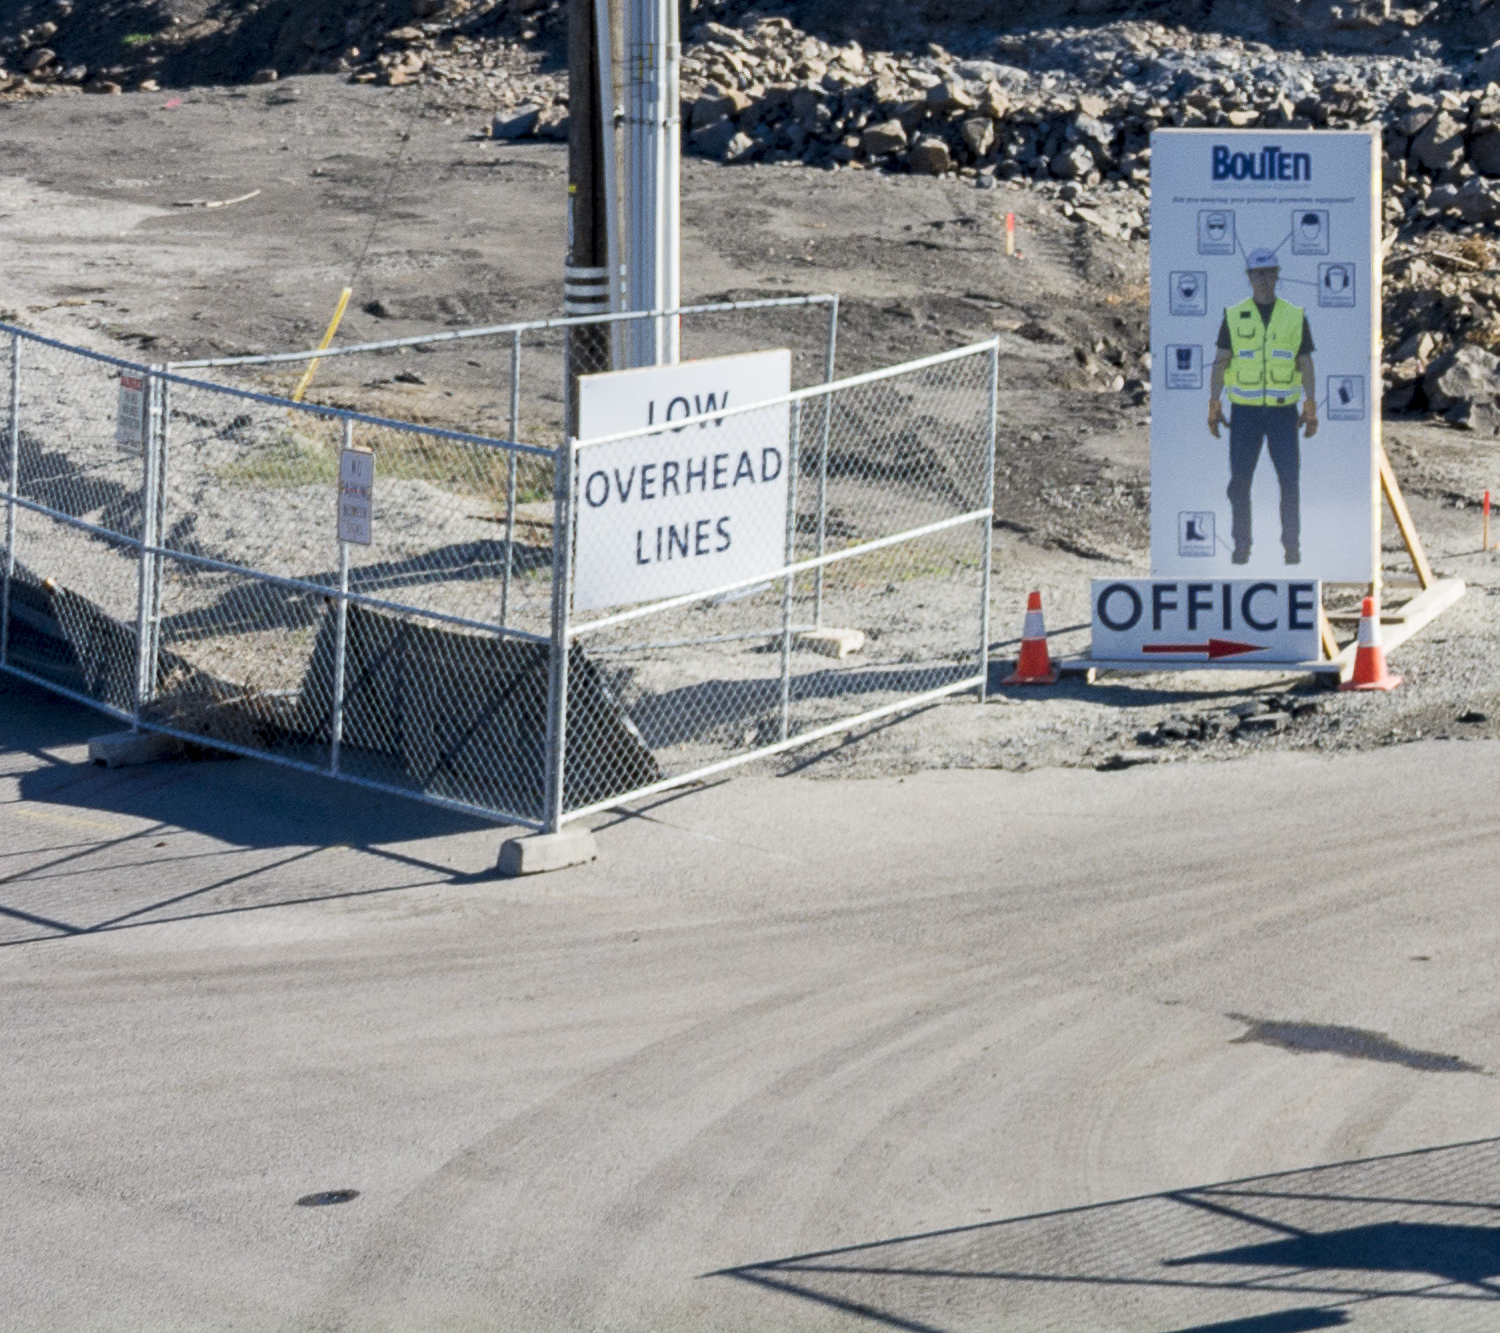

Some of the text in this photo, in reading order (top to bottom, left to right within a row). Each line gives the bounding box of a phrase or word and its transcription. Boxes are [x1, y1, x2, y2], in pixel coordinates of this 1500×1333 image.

[647, 391, 729, 436] LOW
[585, 447, 783, 508] OVERHEAD
[636, 516, 732, 565] LINES
[1097, 583, 1314, 631] OFFICE
